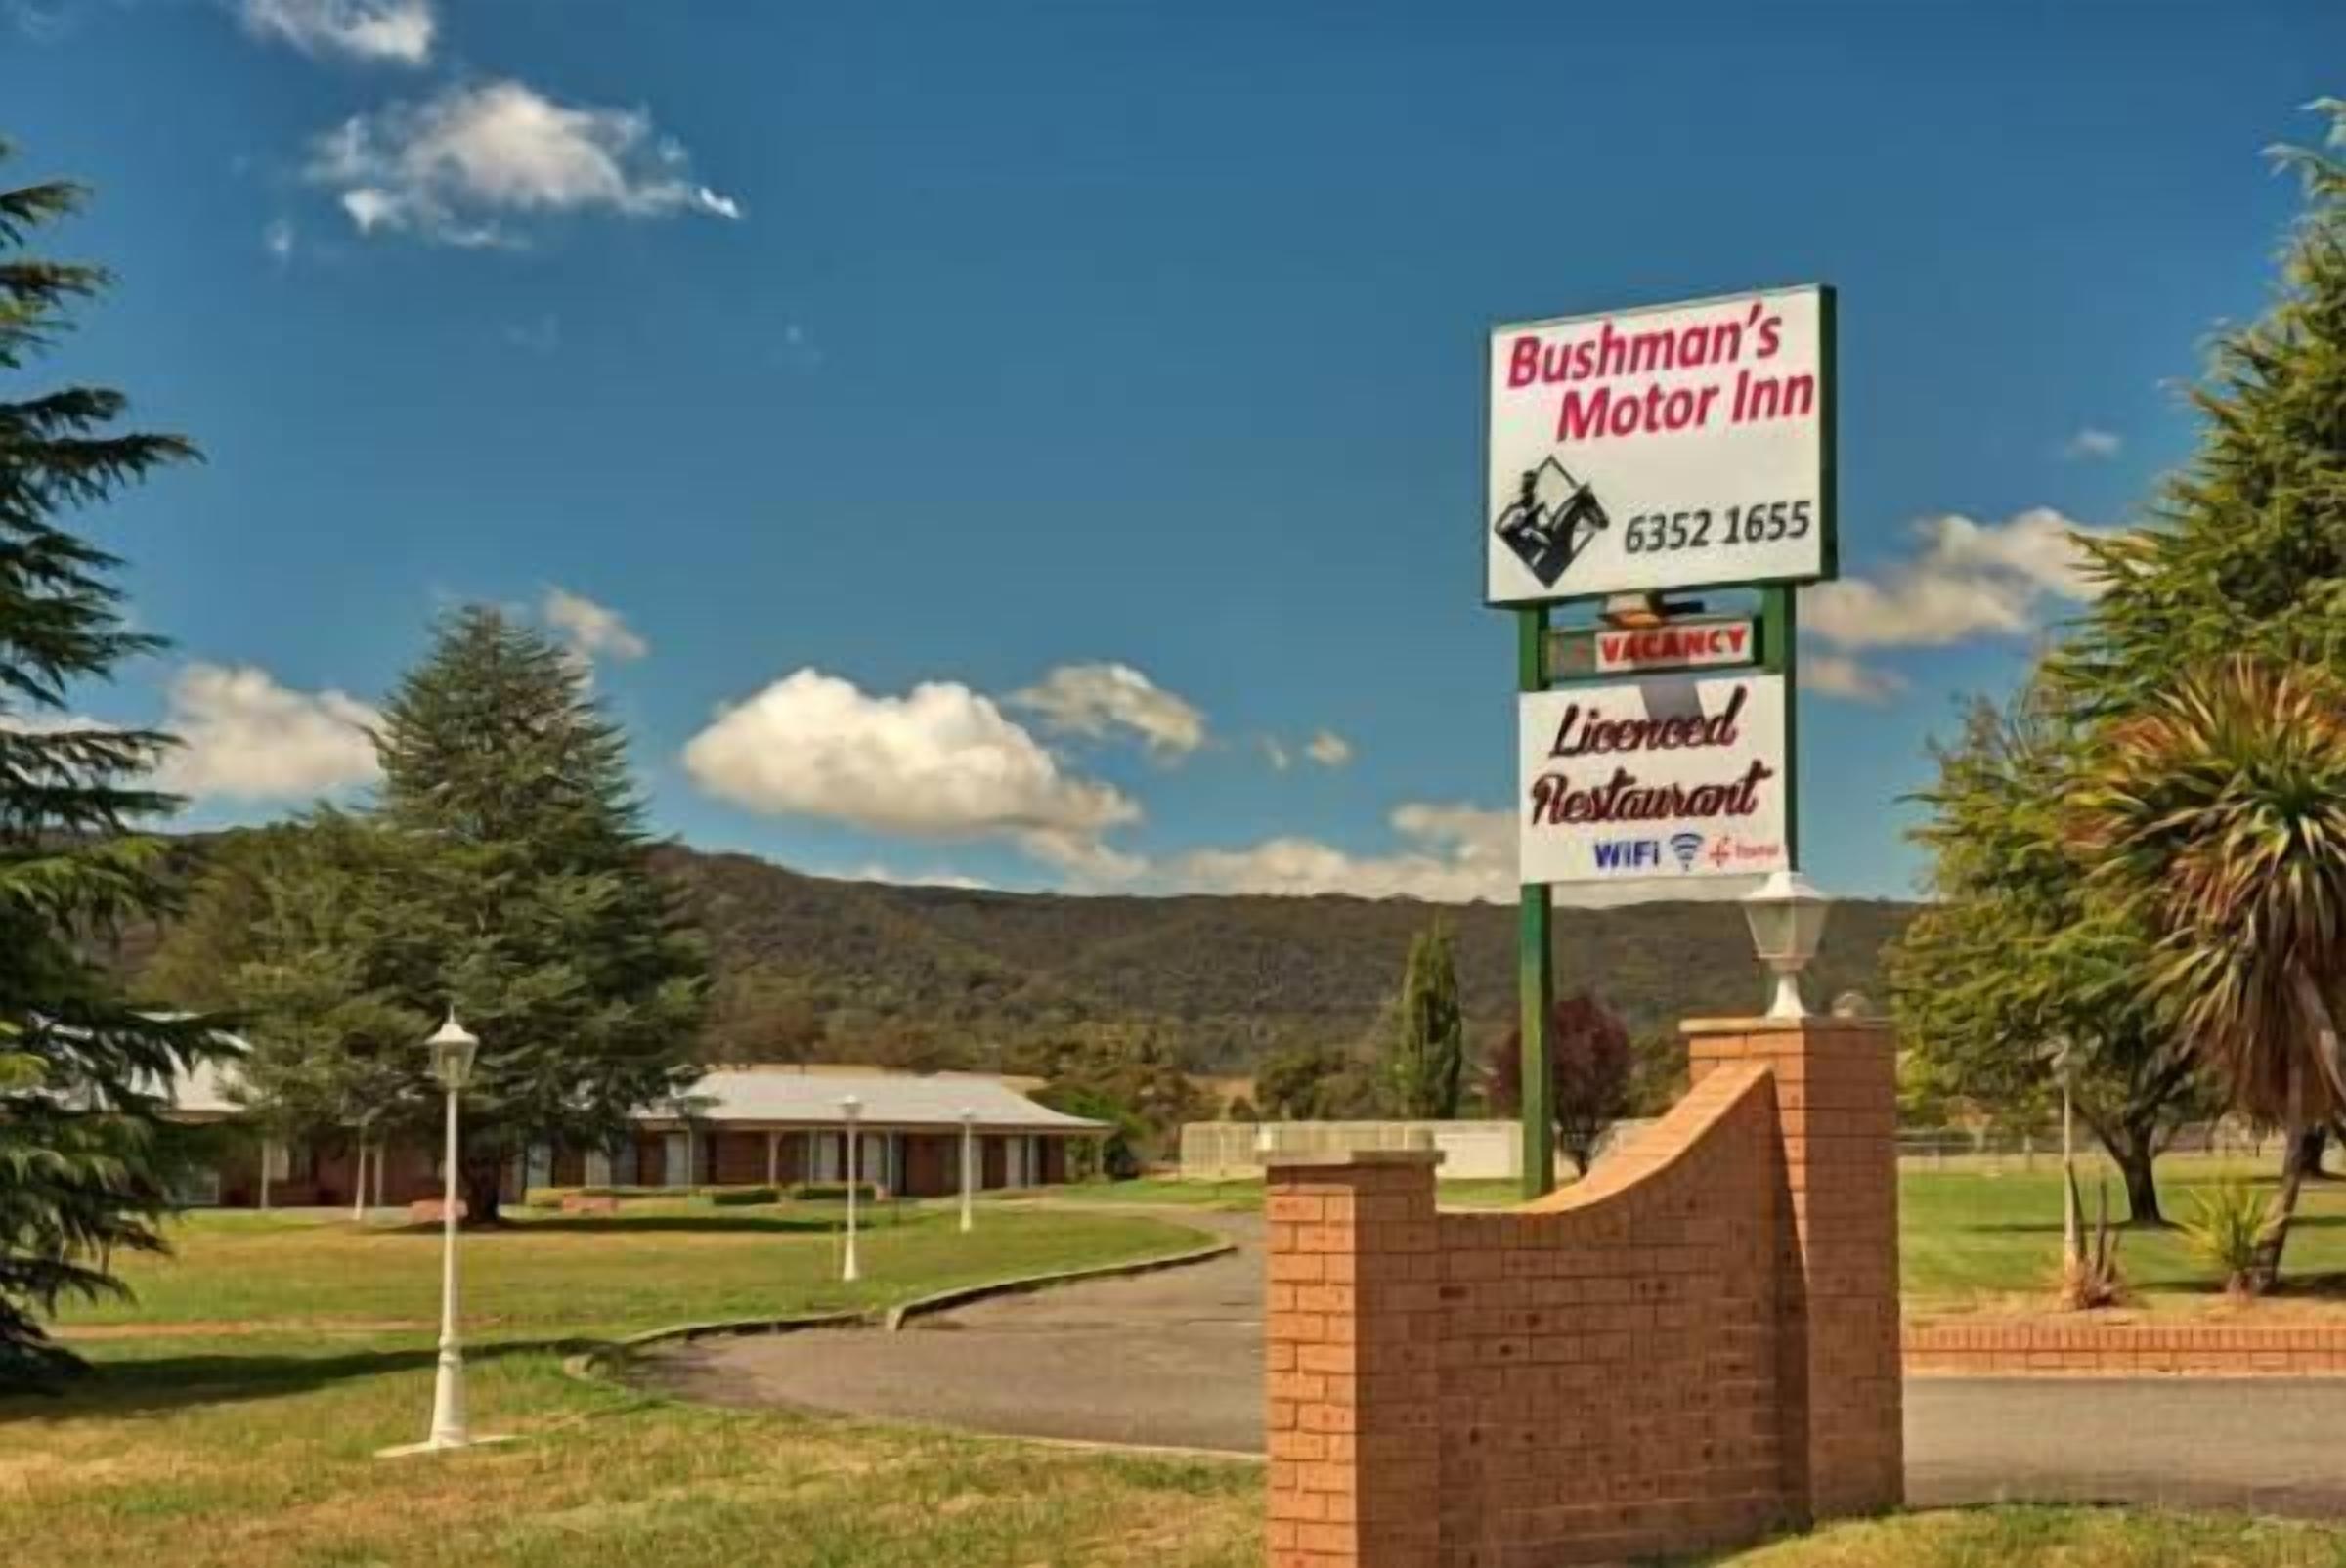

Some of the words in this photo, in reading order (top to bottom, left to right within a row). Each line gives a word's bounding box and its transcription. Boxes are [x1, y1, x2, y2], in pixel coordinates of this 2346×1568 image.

[1507, 302, 1782, 389] Bushman's
[1557, 384, 1719, 442] Motor
[1732, 369, 1814, 423] Inn
[1625, 509, 1712, 554] 6352
[1721, 501, 1811, 544] 1655
[1598, 626, 1747, 664] VACANCY
[1531, 759, 1774, 826] Restaurant
